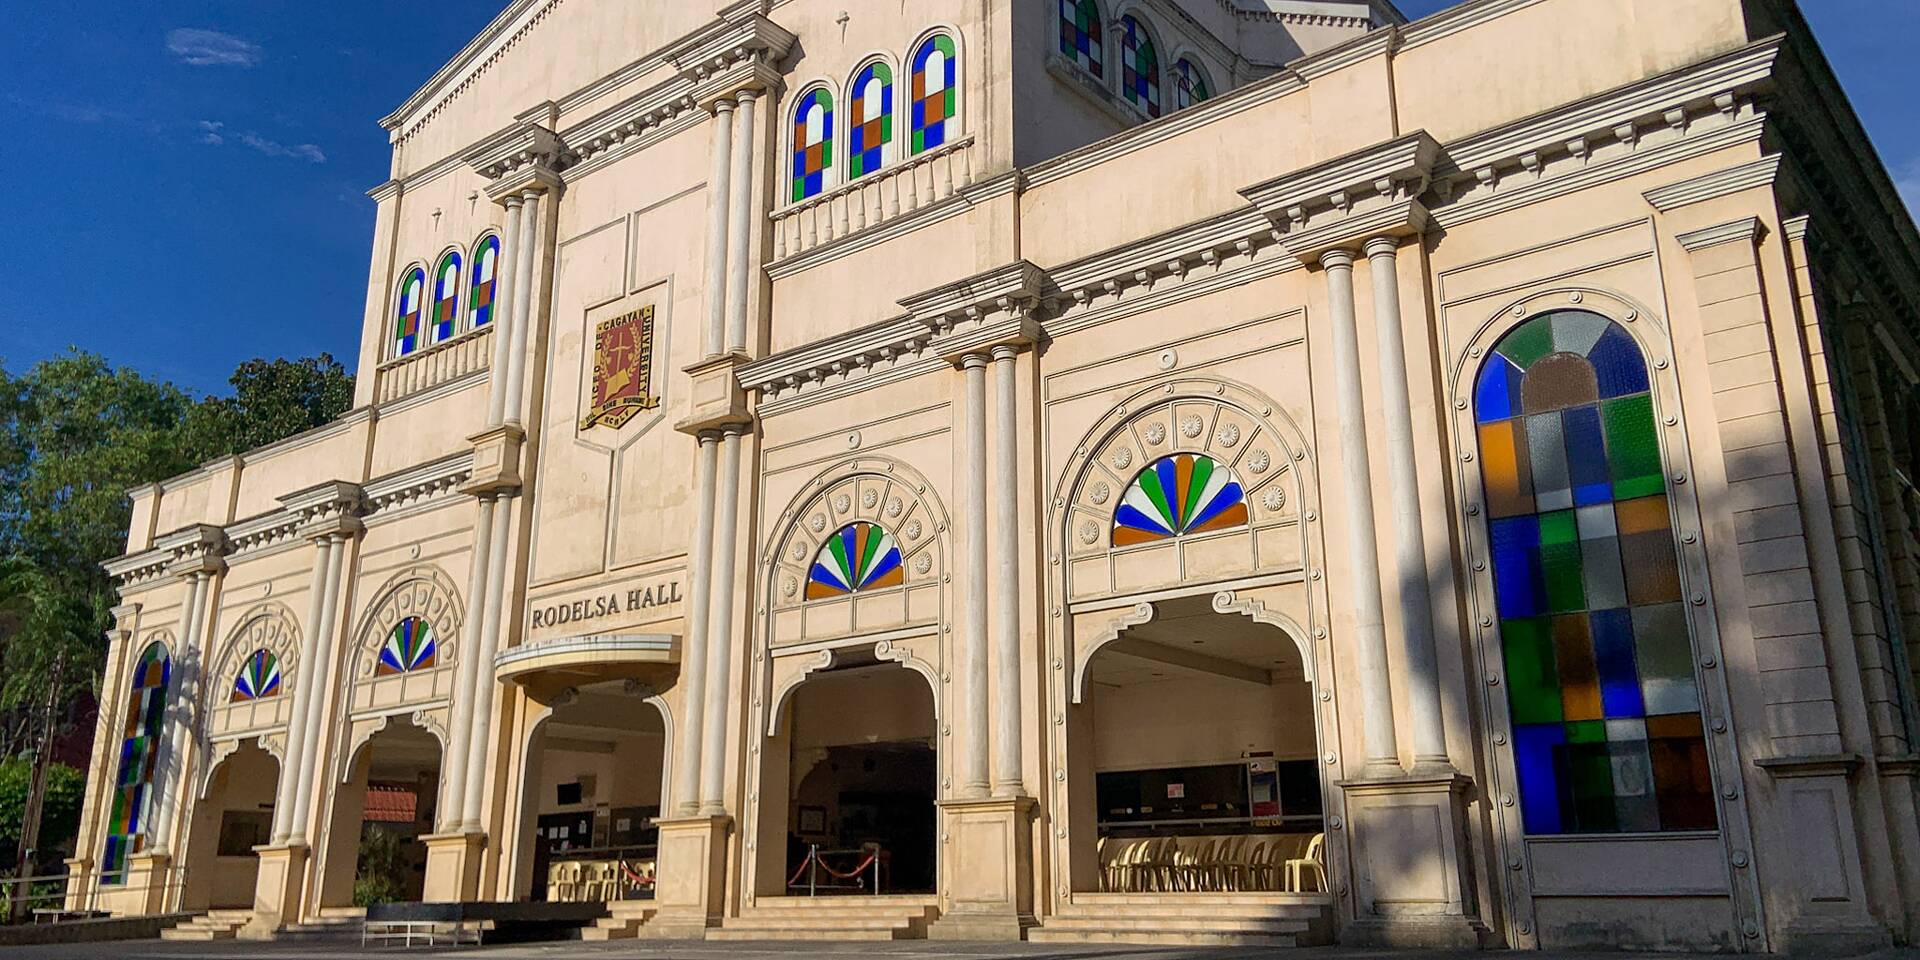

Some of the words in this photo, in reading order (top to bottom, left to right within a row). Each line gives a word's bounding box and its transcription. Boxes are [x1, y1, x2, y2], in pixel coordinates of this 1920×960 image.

[591, 365, 601, 409] LICEO
[596, 333, 603, 350] DE
[603, 308, 645, 331] CAGAYAN
[638, 315, 652, 393] UNIVERSITY
[532, 593, 620, 630] RODELSA
[627, 582, 682, 611] HALL
